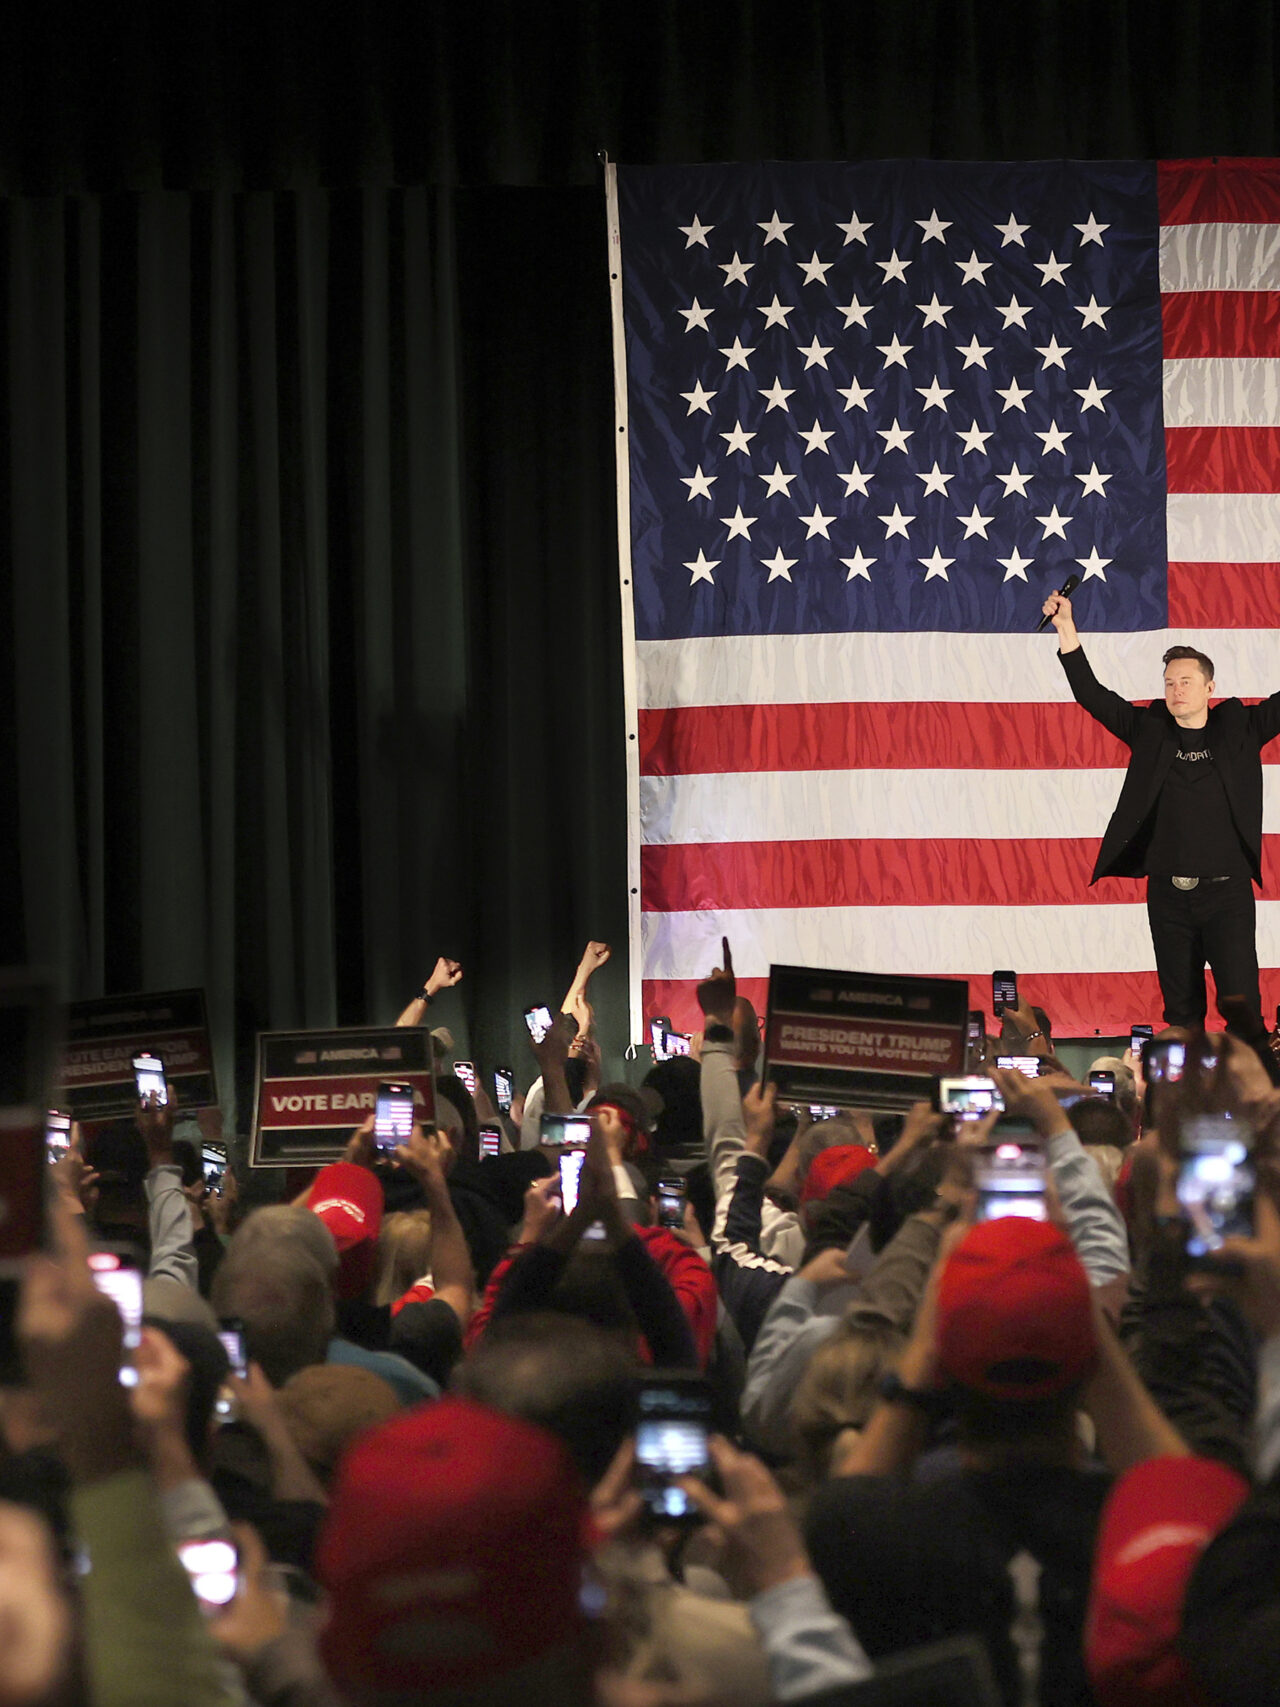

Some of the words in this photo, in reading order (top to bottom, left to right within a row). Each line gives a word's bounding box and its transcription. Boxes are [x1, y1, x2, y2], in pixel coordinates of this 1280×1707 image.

[837, 990, 904, 1007] AMERICA
[781, 1025, 885, 1047] PRESIDENT
[888, 1034, 952, 1052] TRUMP
[319, 1047, 380, 1061] AMERICA
[780, 1040, 827, 1053] WANTS
[829, 1044, 856, 1055] YOU
[857, 1046, 875, 1057] TO
[876, 1048, 910, 1061] VOTE
[911, 1051, 952, 1064] EARLY
[271, 1094, 329, 1113] VOTE
[331, 1092, 376, 1110] EAR
